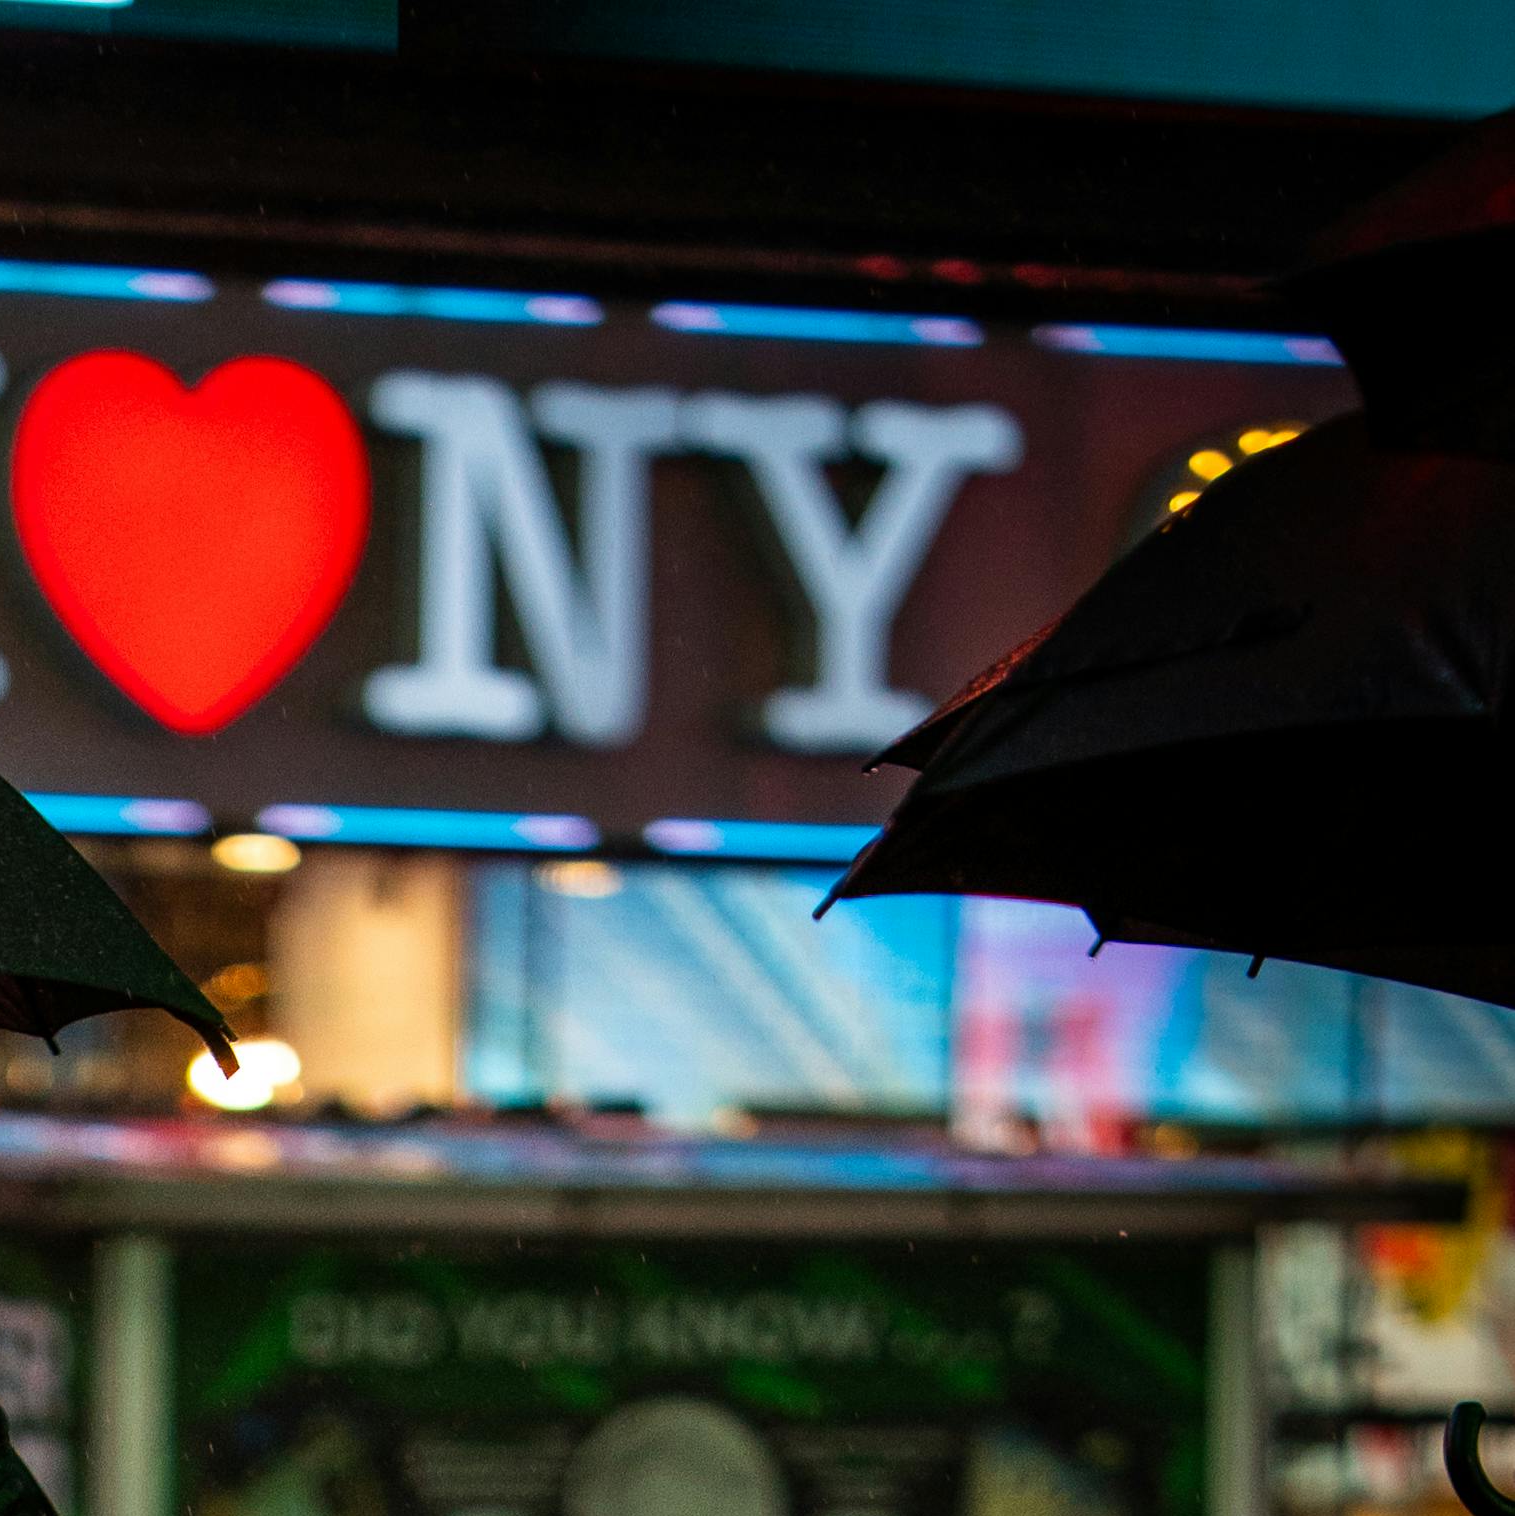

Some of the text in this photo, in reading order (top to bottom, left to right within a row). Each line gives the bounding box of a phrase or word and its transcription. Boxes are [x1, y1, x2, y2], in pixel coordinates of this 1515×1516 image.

[364, 372, 1024, 753] NY
[288, 1291, 446, 1367] DID
[456, 1291, 618, 1367] YOU
[630, 1291, 880, 1367] KNOW
